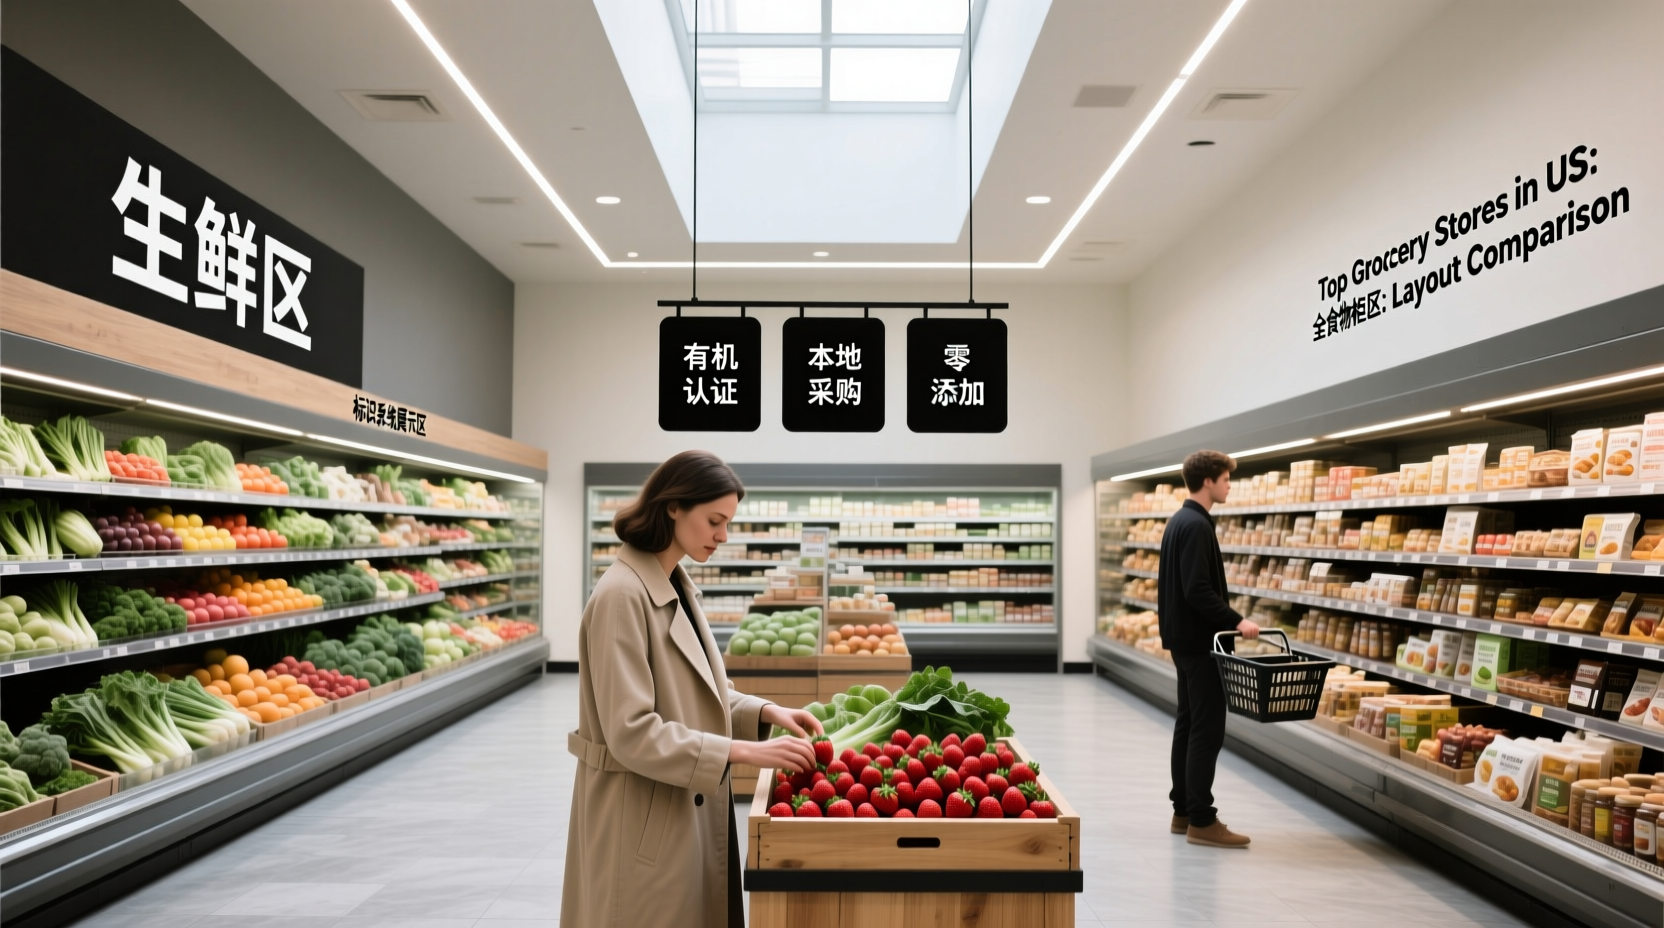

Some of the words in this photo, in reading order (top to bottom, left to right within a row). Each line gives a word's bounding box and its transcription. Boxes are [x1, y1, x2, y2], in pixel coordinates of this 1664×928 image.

[1318, 273, 1348, 303] Top
[1434, 192, 1509, 247] Stores
[1514, 175, 1539, 211] in
[1546, 144, 1598, 193] US:
[111, 156, 312, 352] 生鲜区
[1392, 255, 1462, 309] Layout
[1466, 186, 1630, 276] Comparison
[683, 342, 739, 371] 有机
[808, 342, 862, 371] 本地
[943, 344, 971, 372] 零
[682, 376, 738, 405] 认证
[807, 377, 862, 406] 采购
[930, 377, 985, 407] 添加
